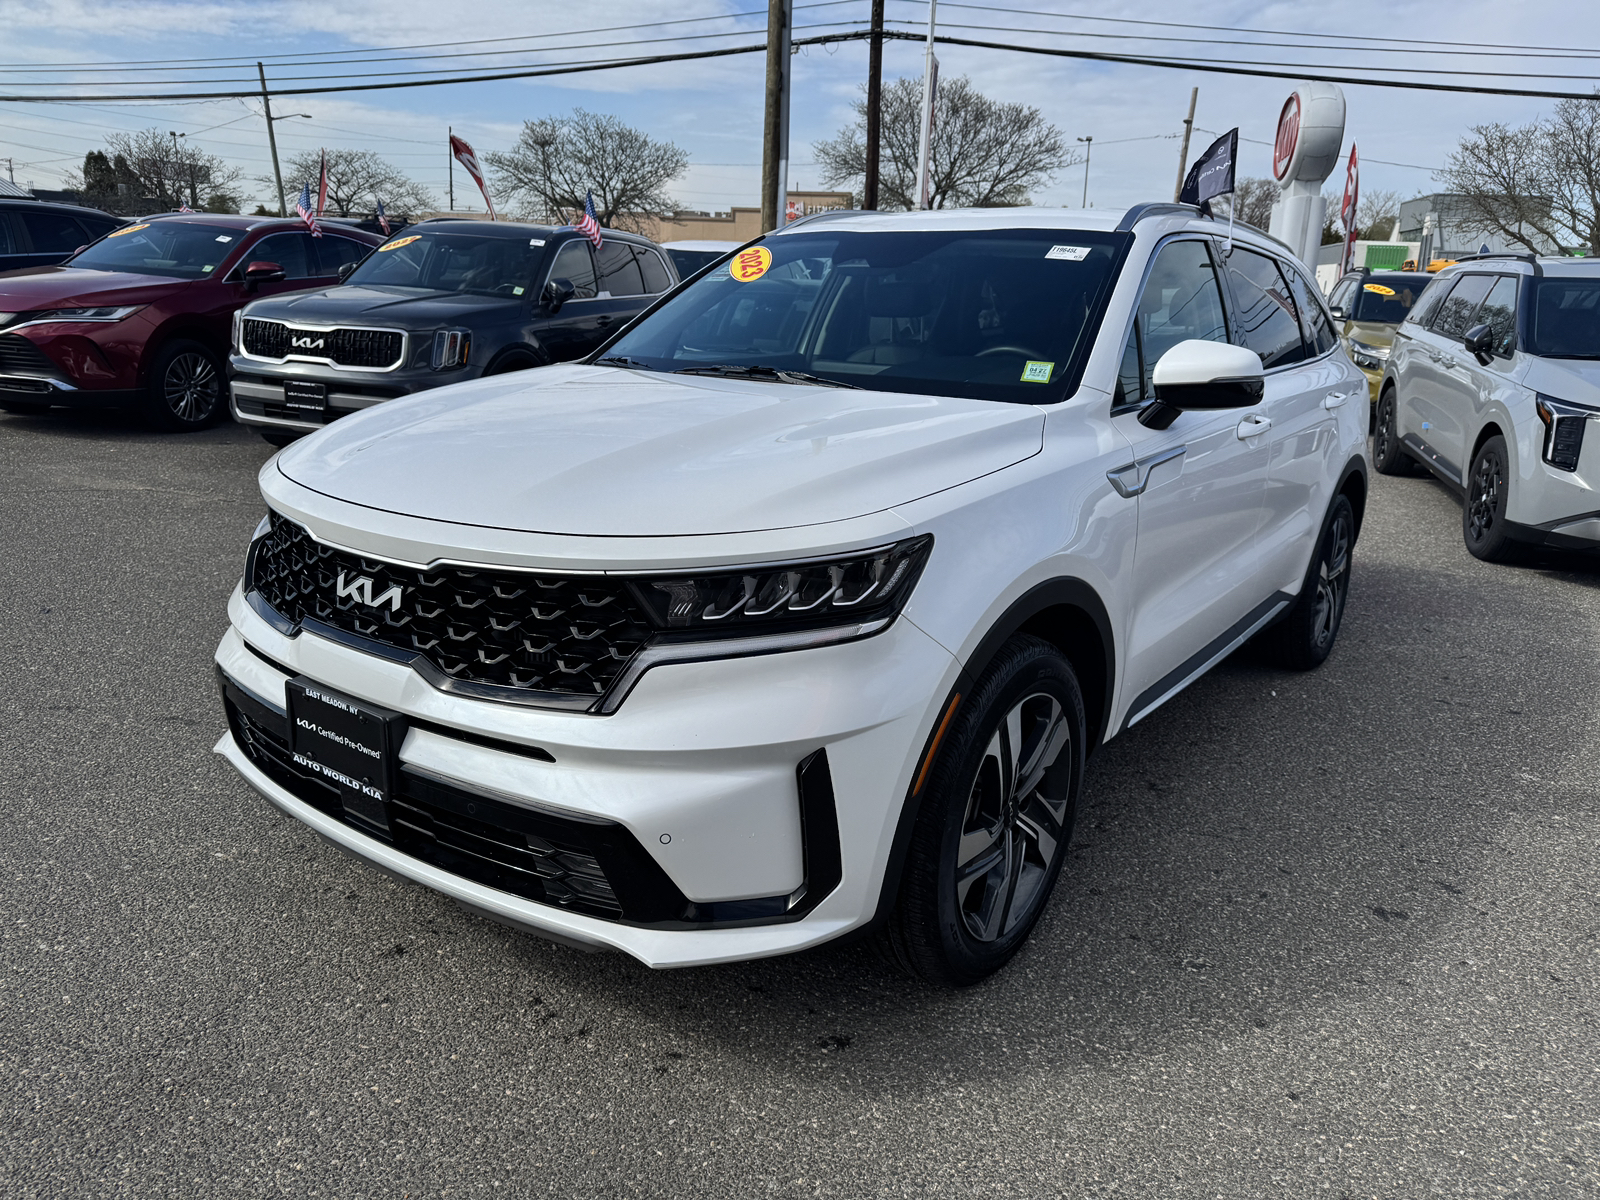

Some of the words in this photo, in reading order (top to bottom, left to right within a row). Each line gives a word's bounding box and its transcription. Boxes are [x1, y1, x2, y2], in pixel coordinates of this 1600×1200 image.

[739, 249, 764, 279] 2023
[291, 336, 324, 349] KIA
[336, 571, 403, 612] KIA
[305, 688, 321, 700] EAST
[349, 705, 359, 716] NY
[296, 717, 317, 732] KIA
[317, 726, 344, 745] Certified
[344, 737, 381, 760] Pre-Owned
[293, 754, 321, 772] AUTO
[322, 767, 360, 790] WORLD
[362, 785, 383, 801] KIA
